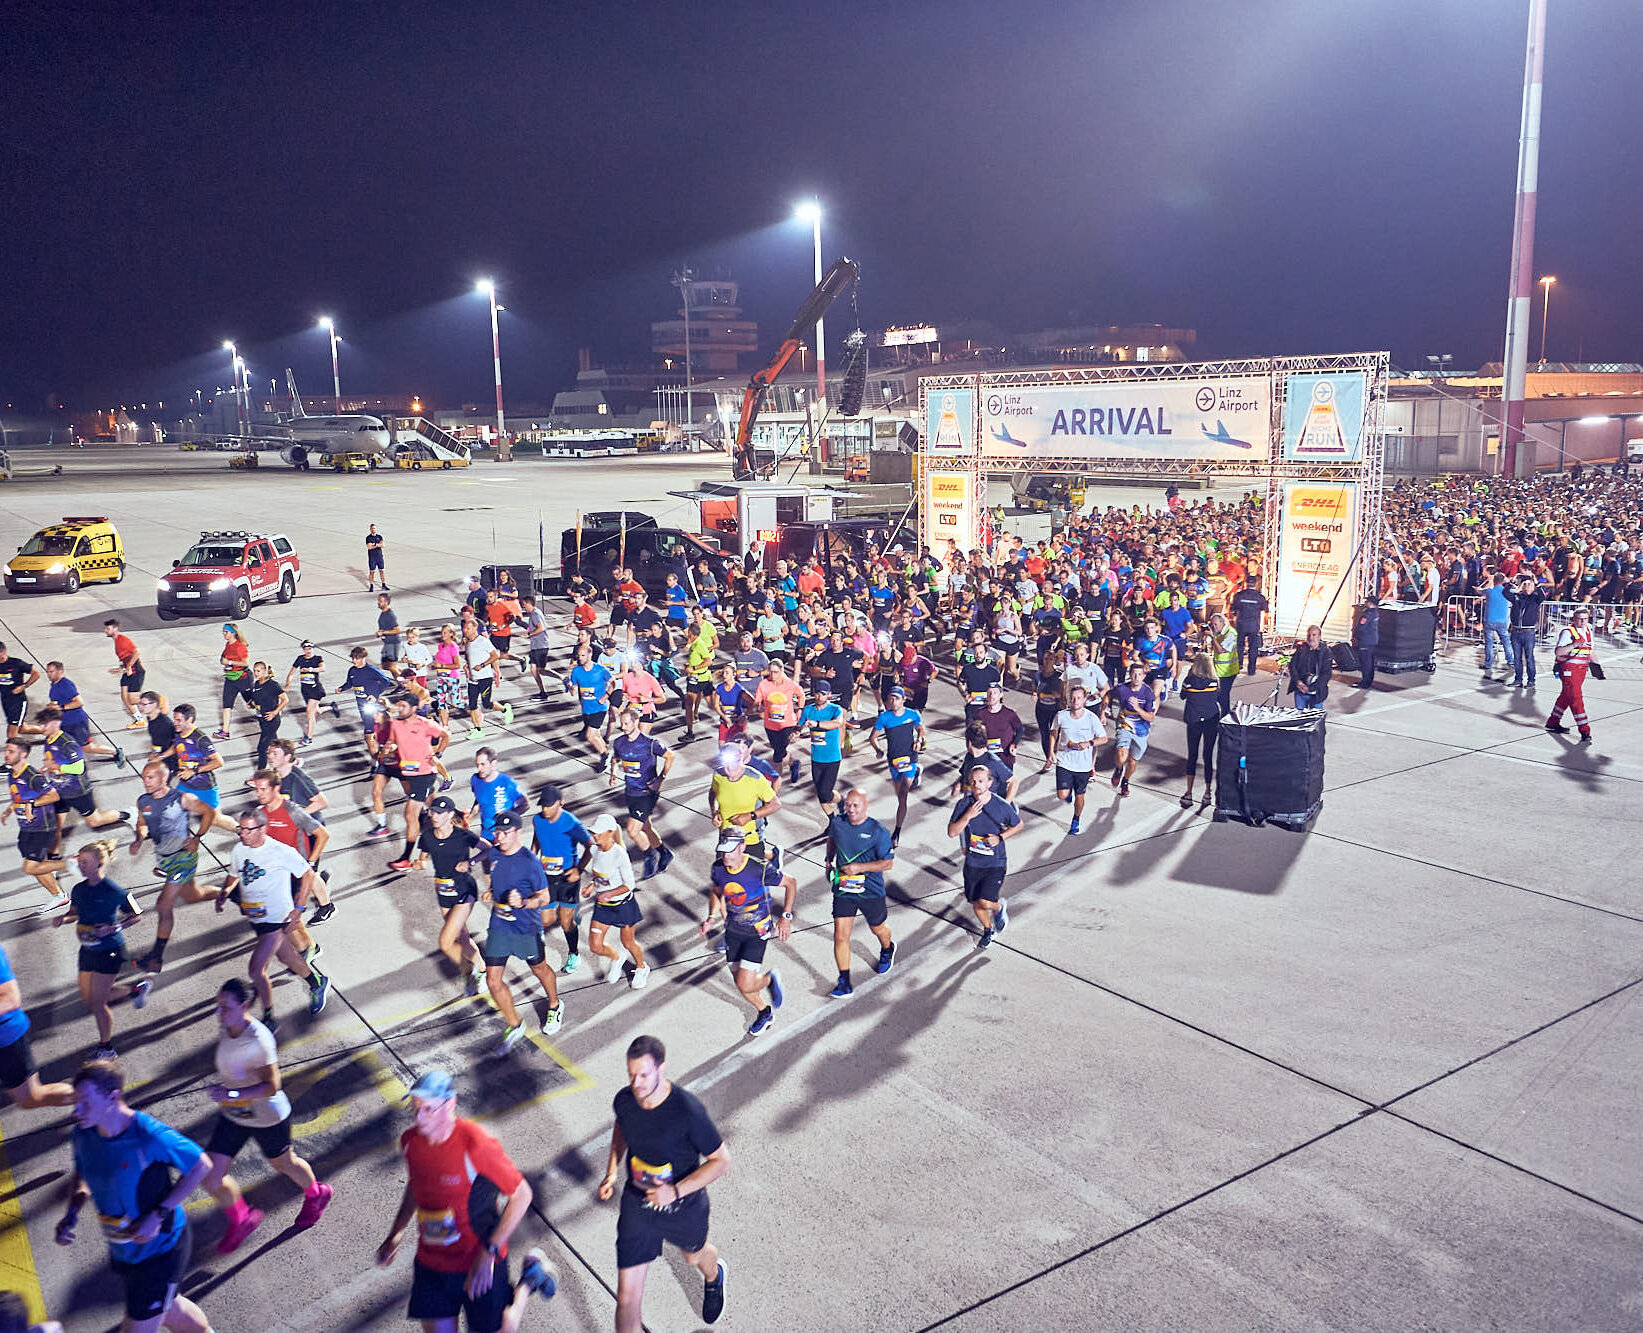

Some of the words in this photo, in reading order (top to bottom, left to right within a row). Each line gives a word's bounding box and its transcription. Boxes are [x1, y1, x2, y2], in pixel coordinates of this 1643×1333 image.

[1219, 386, 1242, 398] Linz
[1004, 394, 1021, 405] Linz
[1004, 405, 1033, 417] Airport
[1218, 399, 1259, 414] Airport
[1050, 406, 1173, 436] ARRIVAL
[1306, 433, 1336, 446] RUN
[937, 483, 960, 491] DHL
[933, 501, 963, 510] weekend
[1300, 498, 1338, 508] DHL
[1291, 521, 1343, 533] weekend
